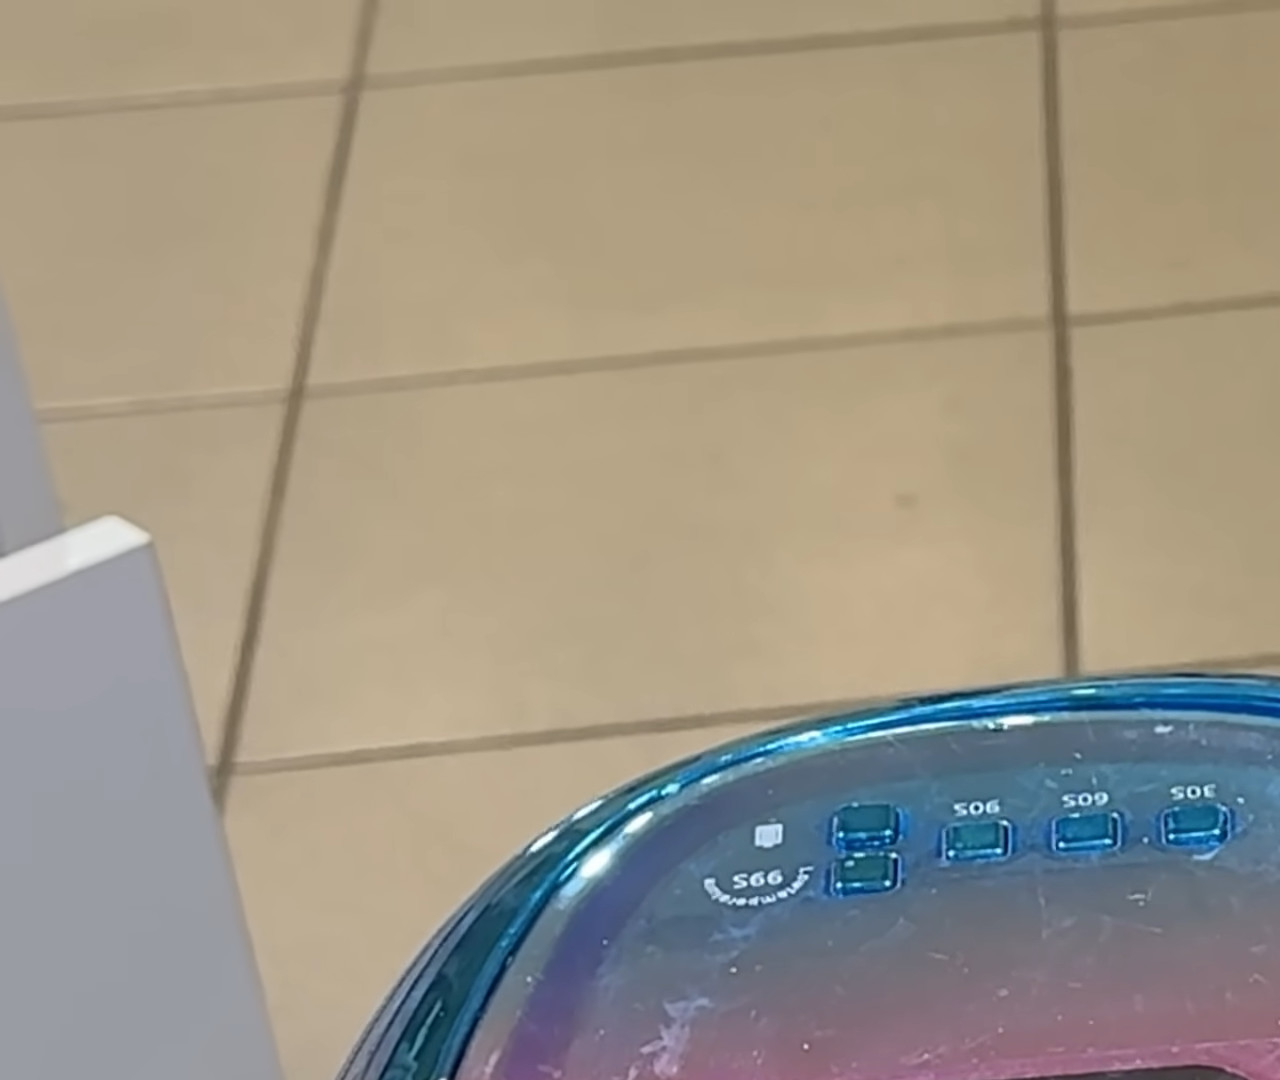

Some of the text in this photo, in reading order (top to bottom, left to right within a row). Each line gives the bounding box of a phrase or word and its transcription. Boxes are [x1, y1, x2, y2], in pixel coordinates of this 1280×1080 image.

[1061, 791, 1110, 809] 60S
[1169, 783, 1217, 801] 30S
[952, 799, 1001, 817] 90S
[732, 869, 784, 890] 99S
